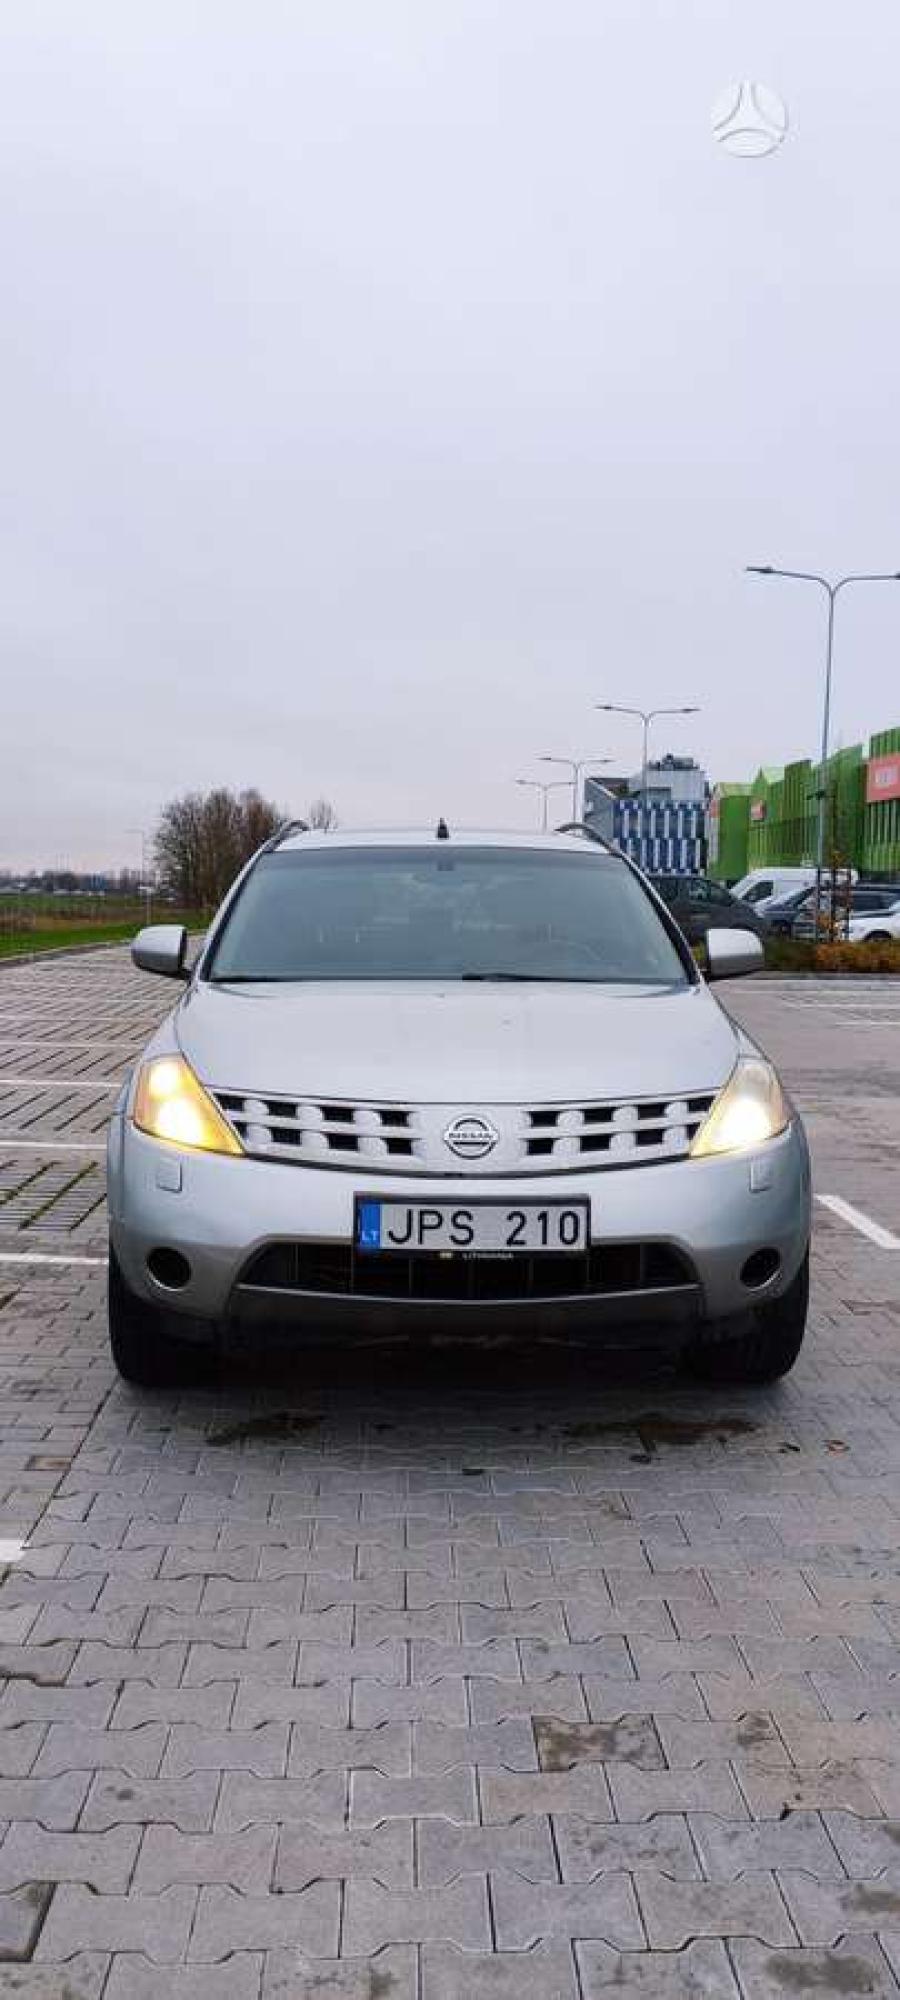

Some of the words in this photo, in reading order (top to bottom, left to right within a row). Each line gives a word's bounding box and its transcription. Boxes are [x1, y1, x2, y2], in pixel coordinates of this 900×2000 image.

[361, 1230, 378, 1241] LT
[388, 1208, 475, 1245] JPS
[506, 1210, 579, 1246] 210
